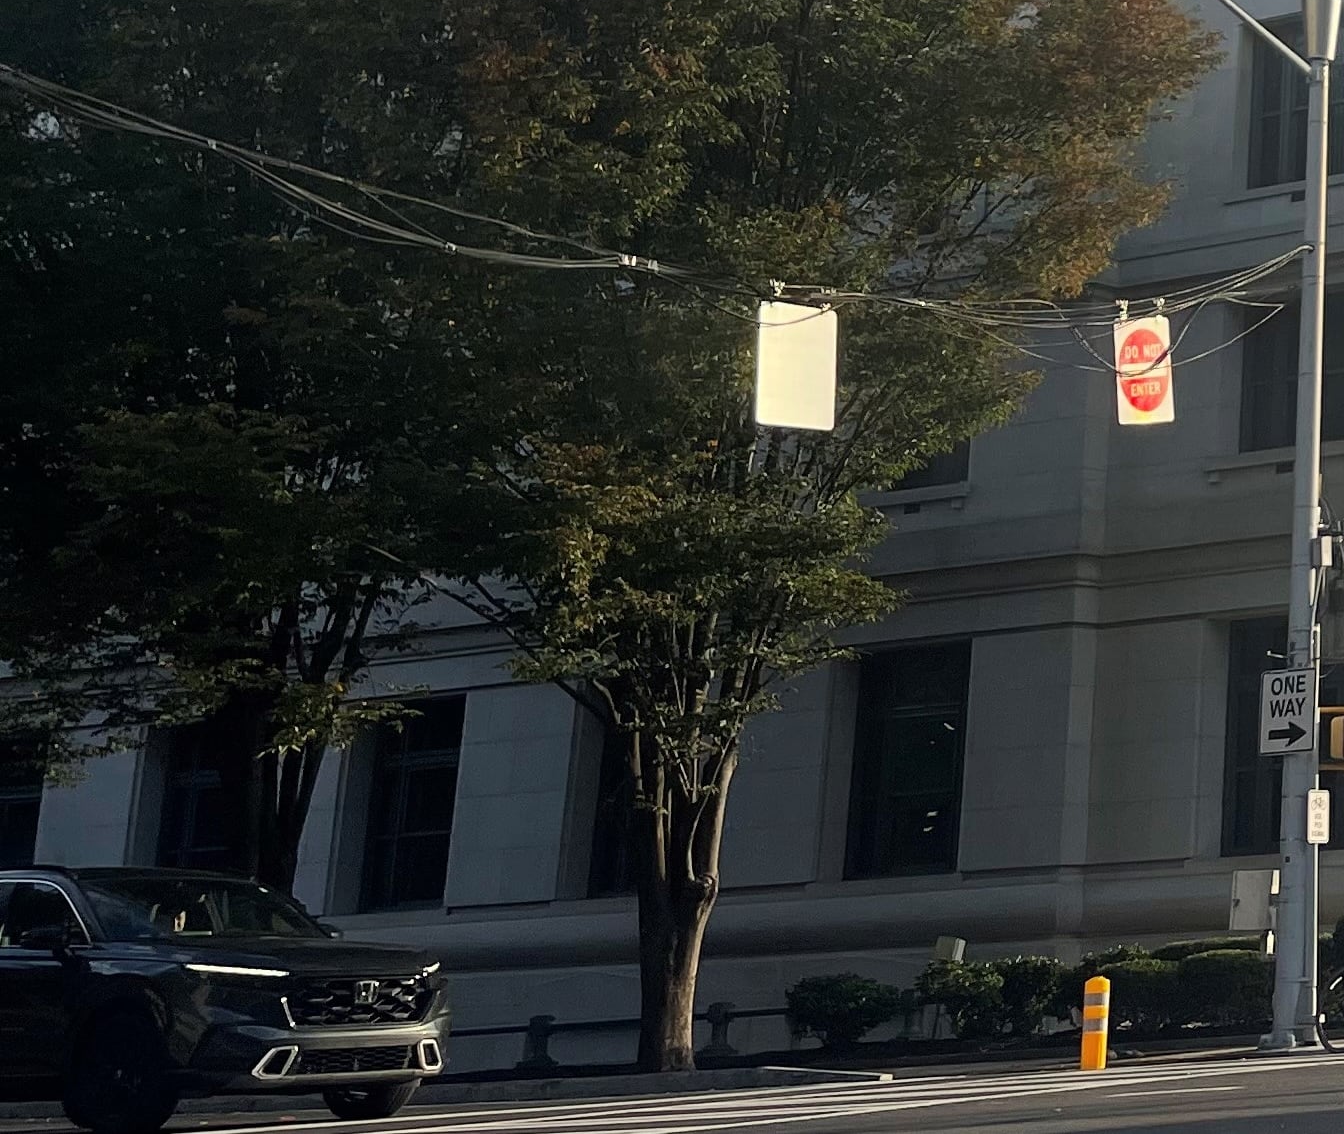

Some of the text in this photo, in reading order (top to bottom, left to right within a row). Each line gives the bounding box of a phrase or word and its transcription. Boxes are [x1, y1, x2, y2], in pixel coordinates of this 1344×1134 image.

[1125, 344, 1163, 359] DO NOT
[1130, 381, 1161, 397] ENTER
[1271, 674, 1307, 696] ONE
[1270, 697, 1307, 718] WAY
